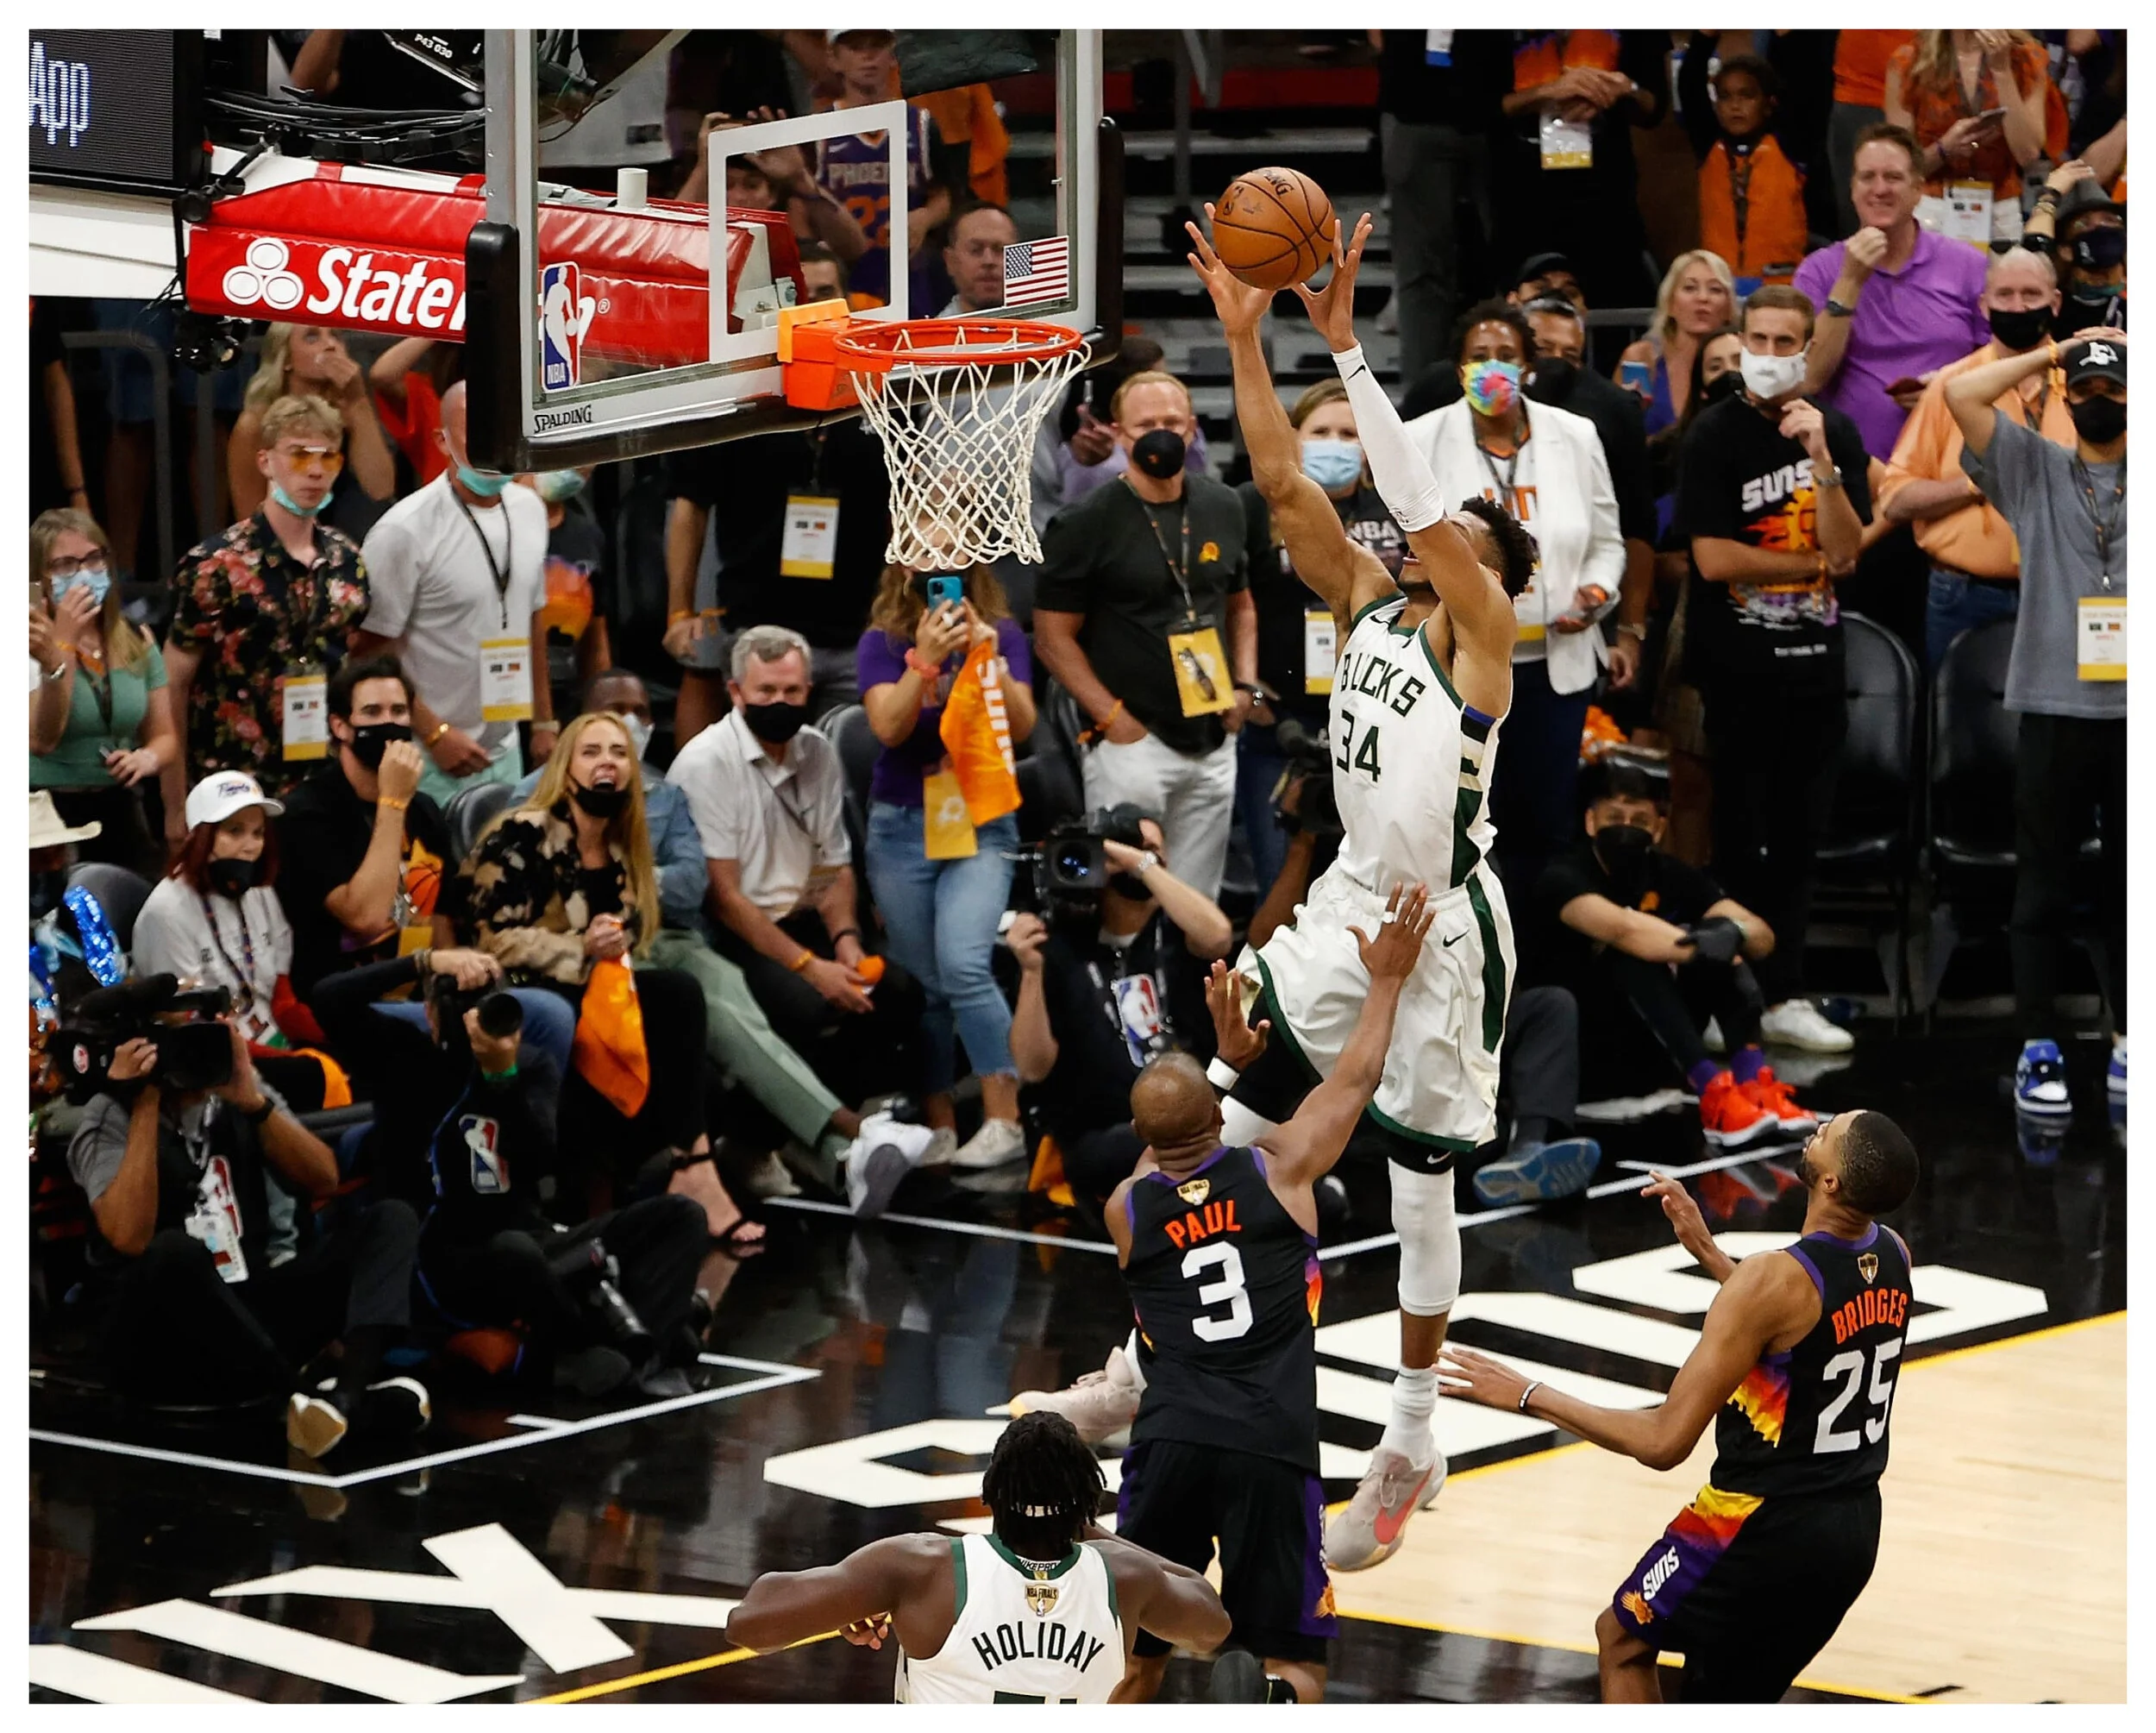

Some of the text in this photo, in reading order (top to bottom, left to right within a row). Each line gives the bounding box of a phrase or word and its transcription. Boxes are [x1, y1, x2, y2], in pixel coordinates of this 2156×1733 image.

[434, 44, 453, 59] 030
[29, 41, 91, 148] App
[306, 247, 454, 329] State
[547, 362, 567, 385] NBA
[534, 404, 592, 434] SPALDING
[1741, 457, 1814, 513] SUNS
[1340, 652, 1426, 718] BUCKS
[1337, 709, 1382, 783] 34
[1164, 1200, 1241, 1249] PAUL
[1181, 1240, 1254, 1342] 3
[1832, 1288, 1908, 1345] BRIDGES
[1813, 1337, 1902, 1454] 25
[1026, 1587, 1057, 1599] NBA FINALS
[1642, 1545, 1680, 1602] SUNS
[971, 1621, 1105, 1673] HOLIDAY
